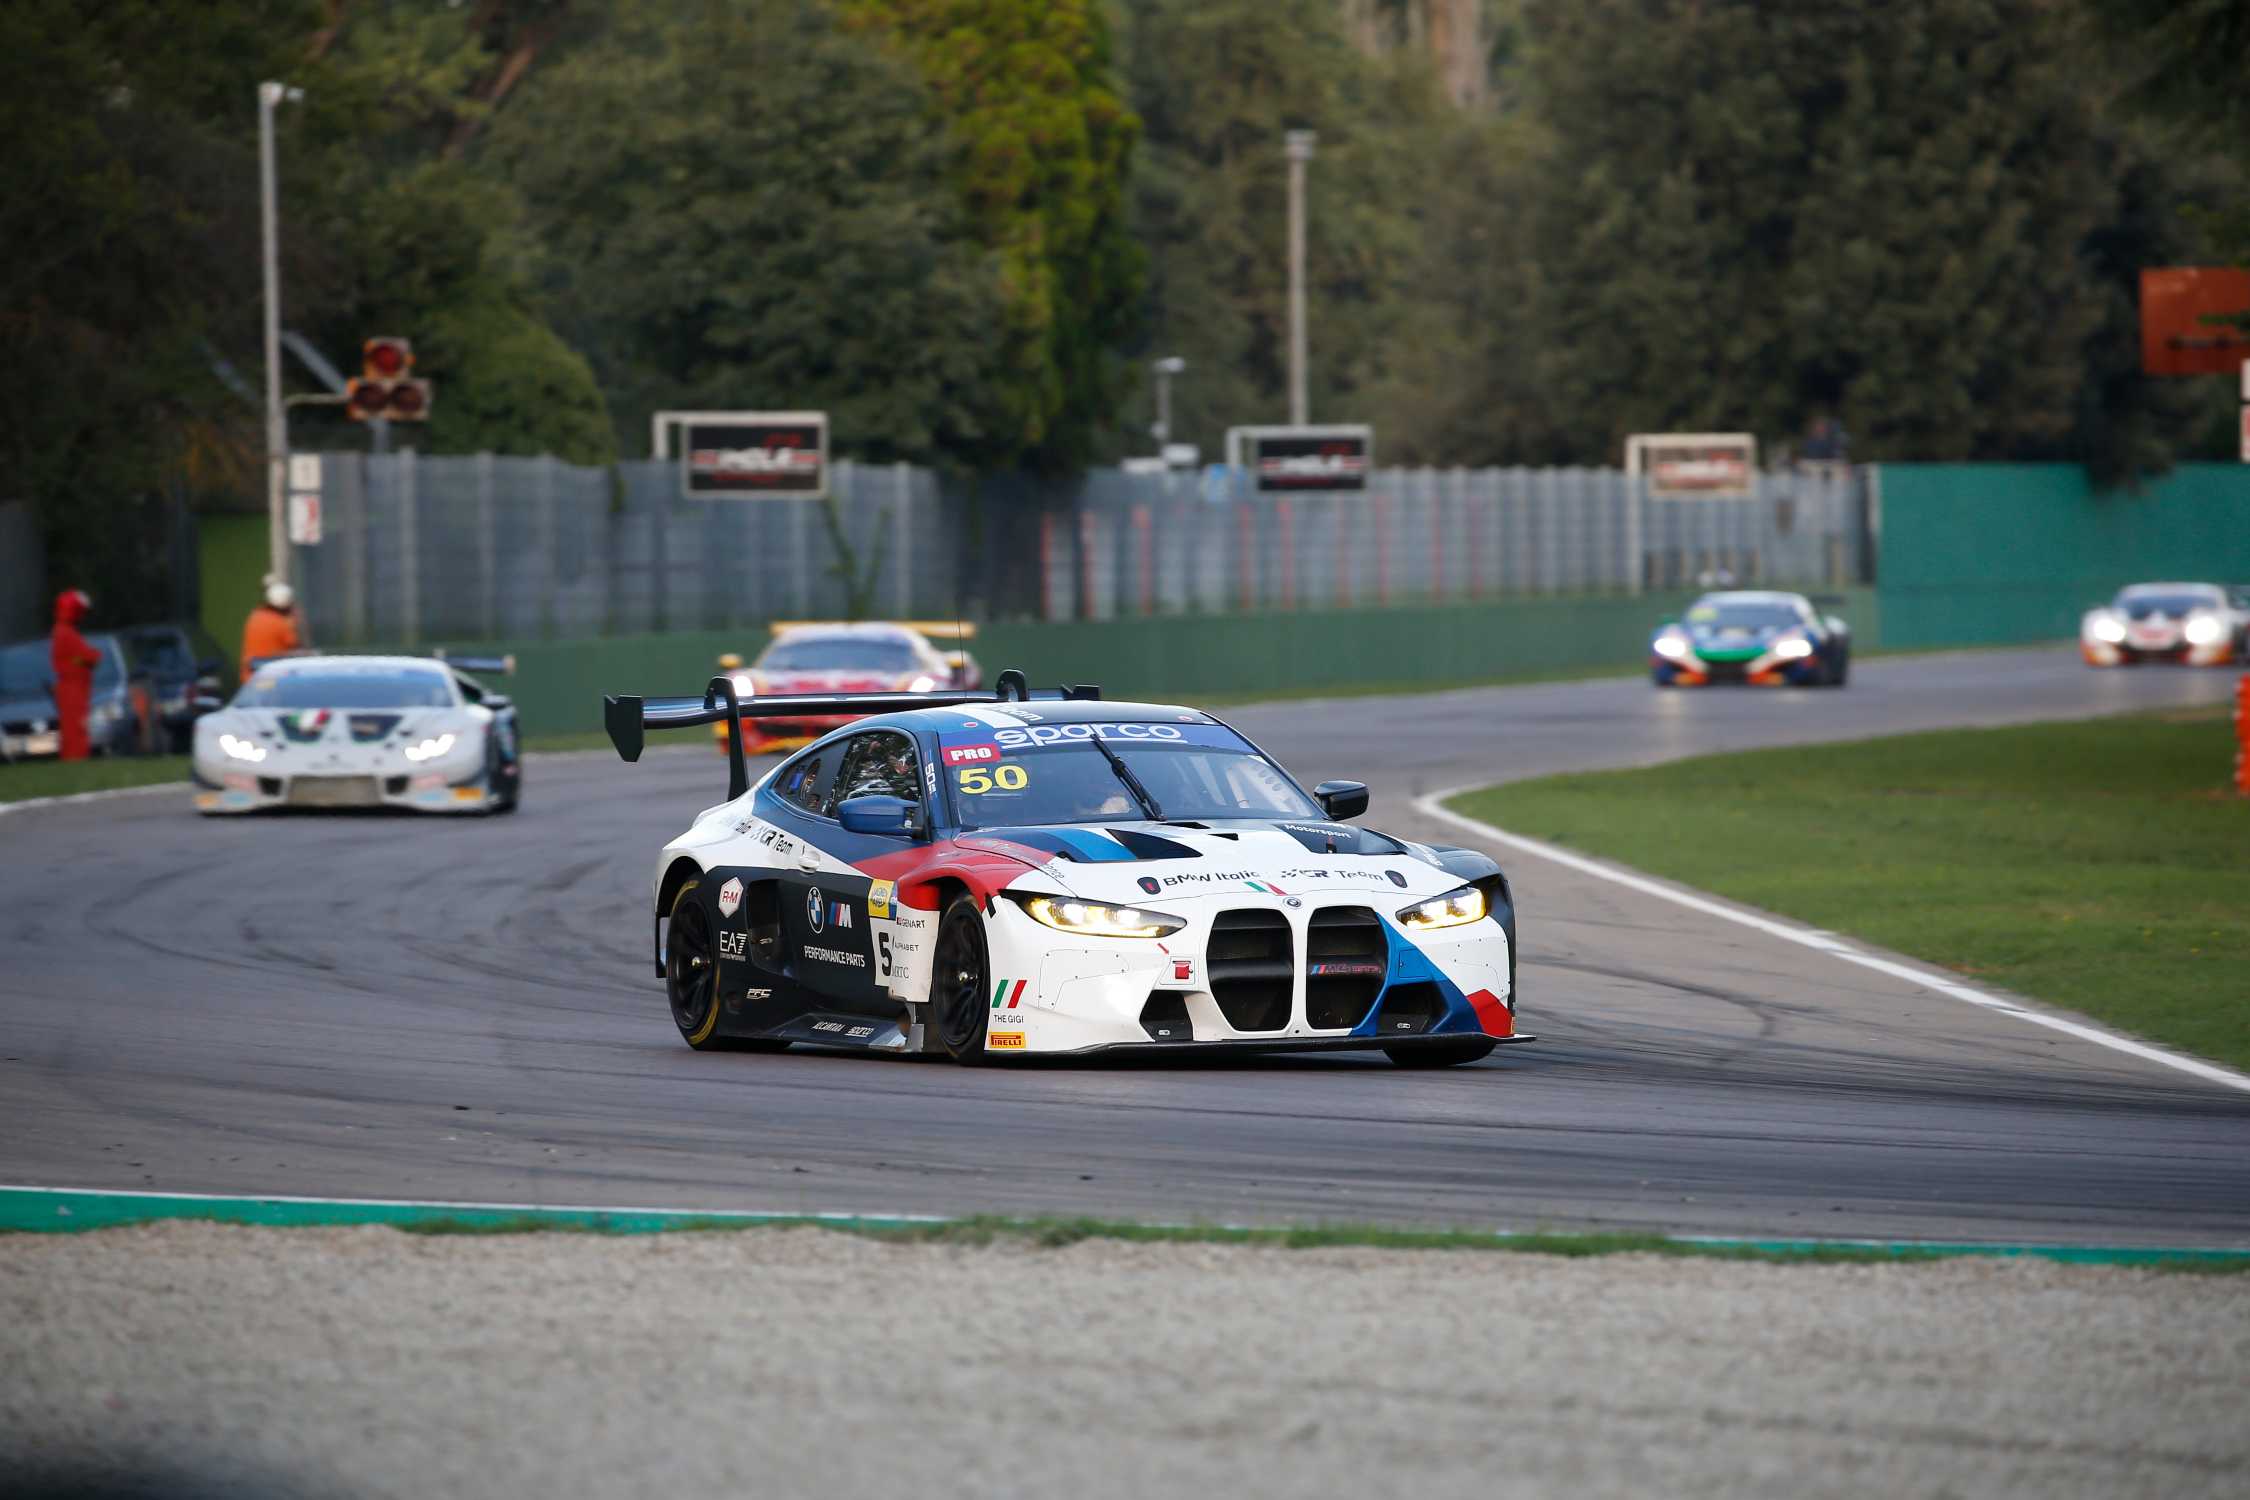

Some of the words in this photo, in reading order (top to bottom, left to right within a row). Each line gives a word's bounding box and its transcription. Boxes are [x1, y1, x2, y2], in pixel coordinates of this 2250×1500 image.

[994, 723, 1186, 748] sparco
[950, 747, 992, 762] PRO
[959, 765, 1028, 794] 50
[1284, 824, 1353, 839] Motorsport
[1163, 872, 1211, 887] BMW
[1335, 870, 1384, 881] Team
[720, 930, 748, 955] EA7
[804, 944, 846, 965] PERFORMANCE
[846, 952, 866, 968] PARTS
[993, 1014, 1007, 1024] THE
[1008, 1015, 1024, 1024] GIGI
[991, 1034, 1022, 1046] PIRELLI
